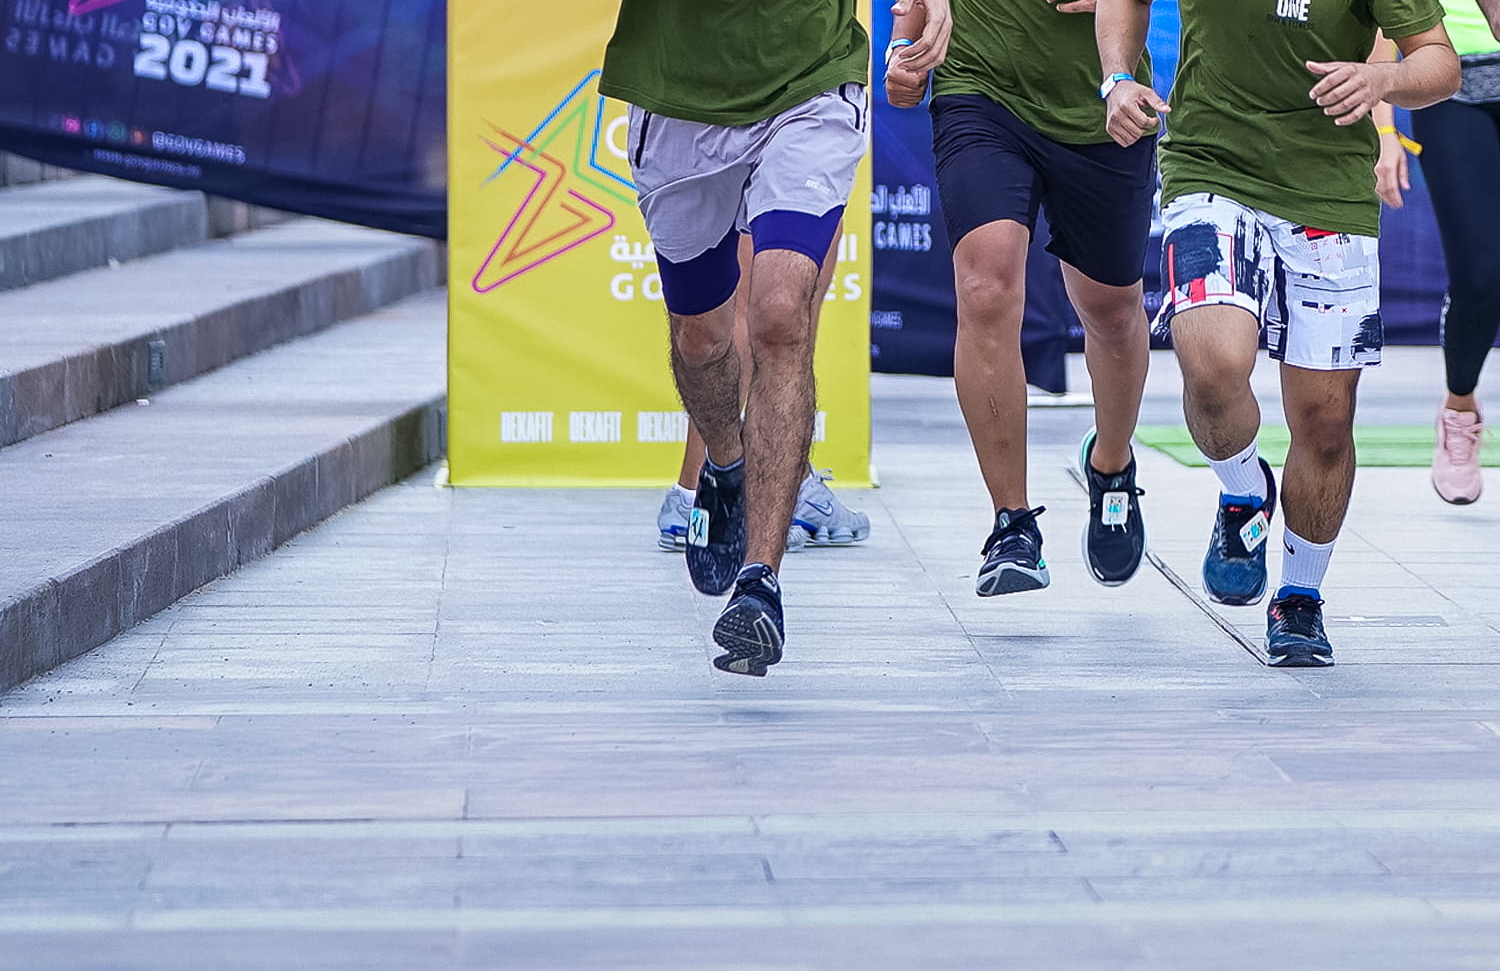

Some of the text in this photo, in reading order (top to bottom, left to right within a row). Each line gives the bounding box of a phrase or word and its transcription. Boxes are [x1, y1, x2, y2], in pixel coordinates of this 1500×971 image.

[142, 11, 194, 39] GOV
[199, 21, 280, 56] GAMES
[133, 32, 272, 99] 2021
[873, 221, 932, 252] GAMES
[610, 273, 664, 302] GO
[501, 411, 554, 443] DEKAFIT
[569, 411, 622, 443] DEKAFIT
